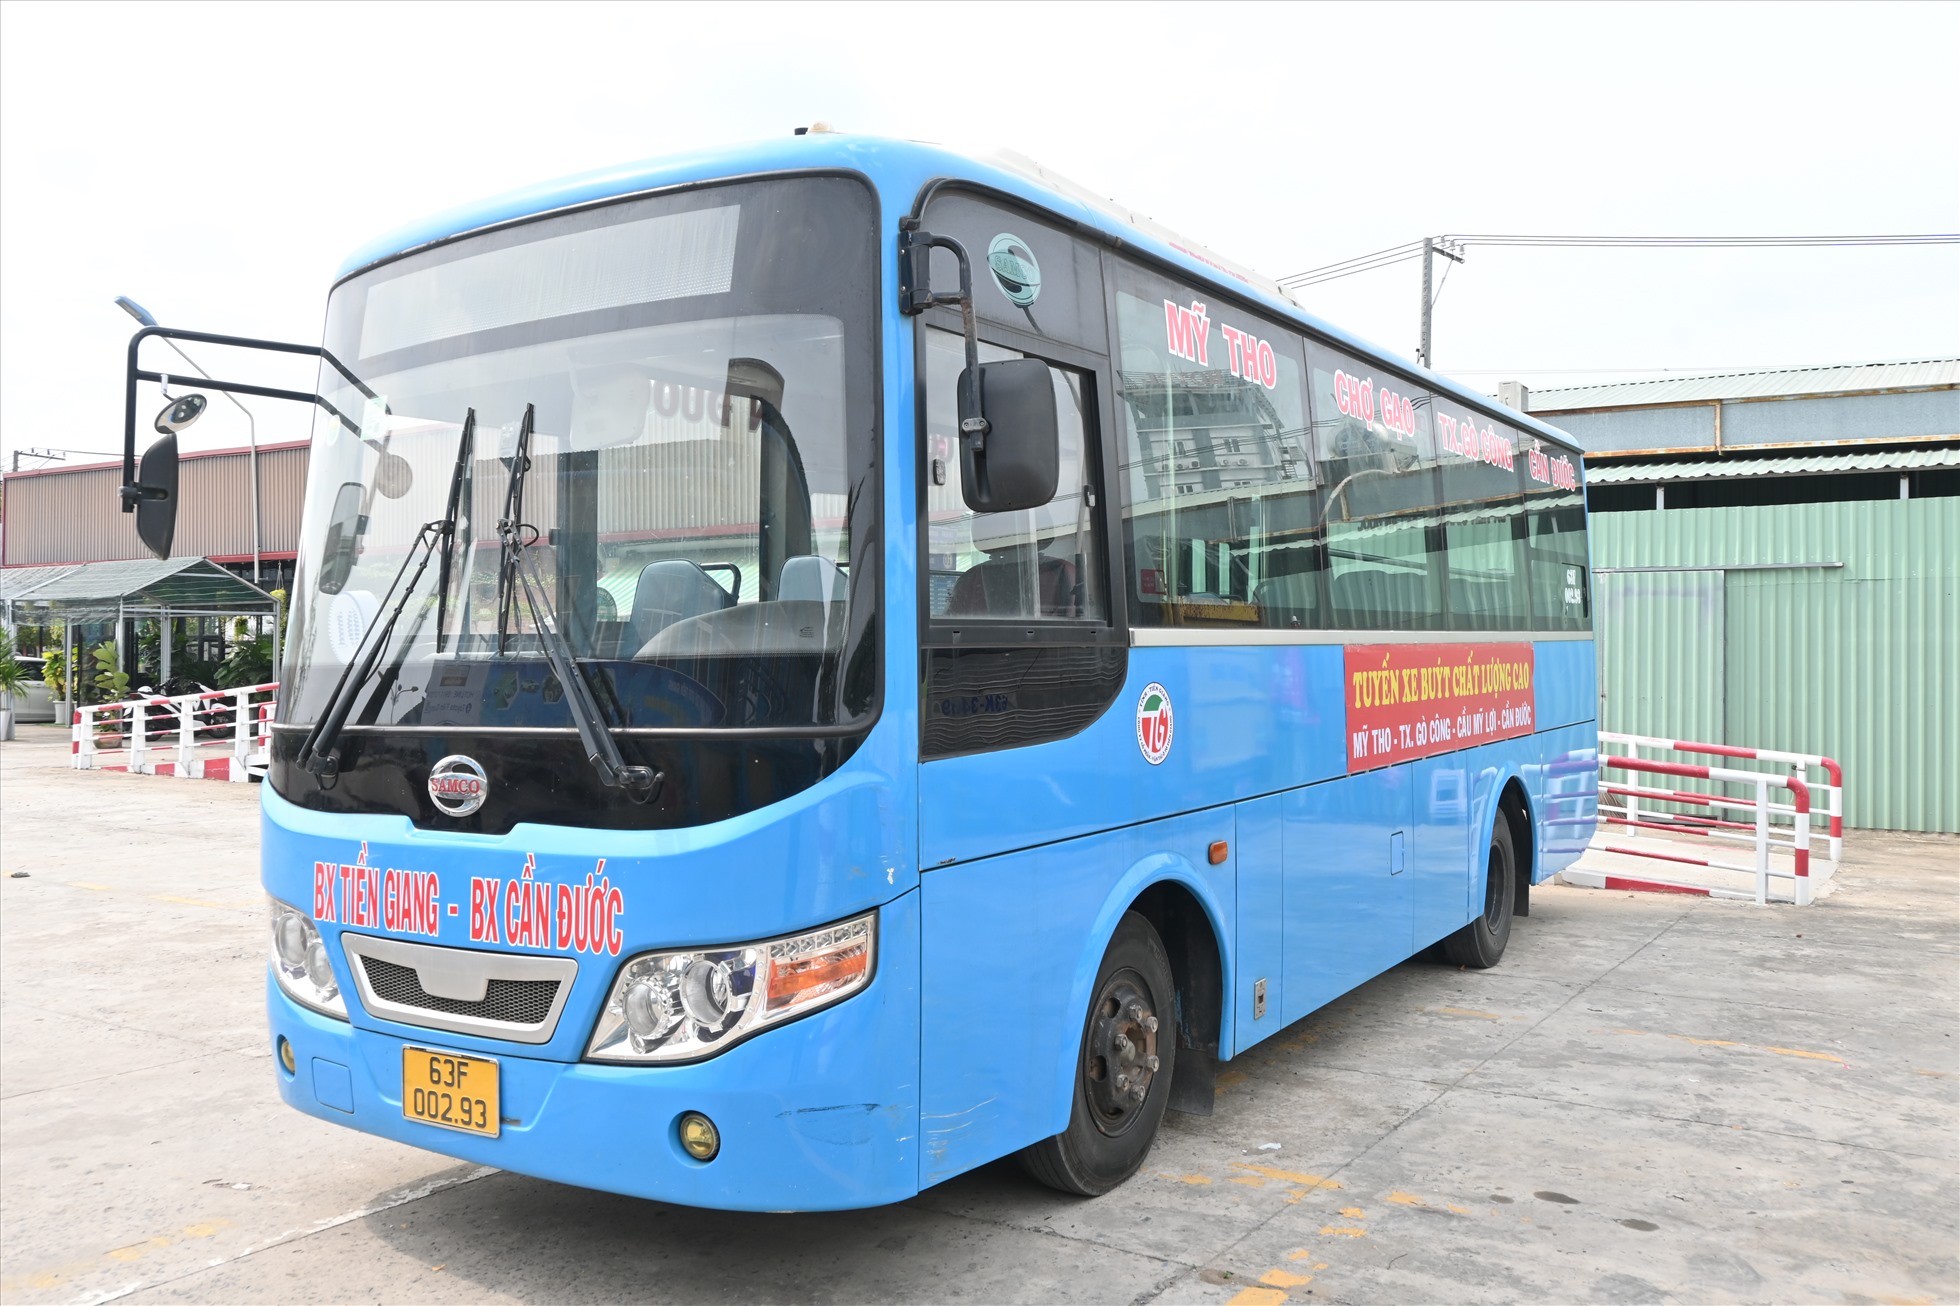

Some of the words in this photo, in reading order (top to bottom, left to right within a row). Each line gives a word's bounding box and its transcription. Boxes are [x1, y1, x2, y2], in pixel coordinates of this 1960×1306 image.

[1163, 298, 1210, 367] MỸ
[1221, 323, 1277, 390] THO
[1333, 369, 1375, 431] CHỢ
[1379, 386, 1415, 441] GẠO
[1480, 423, 1515, 473] CÔNG
[1529, 439, 1550, 485] CẦN
[1551, 454, 1576, 492] ĐƯỚC
[1353, 652, 1400, 709] TUYẾN
[1402, 668, 1418, 703] XE
[1421, 657, 1450, 701] BUÝT
[1452, 650, 1480, 697] CHẤT
[1481, 657, 1511, 699] LƯỢNG
[1513, 662, 1530, 691] CAO
[1353, 725, 1369, 759] MỸ
[1371, 728, 1392, 755] THO
[1399, 725, 1414, 749] TX.
[1416, 716, 1428, 747] GÒ
[1429, 713, 1451, 743] CÔNG
[1457, 706, 1472, 738] CẦU
[1473, 708, 1484, 735] MỸ
[1485, 708, 1497, 736] LỢI
[1501, 700, 1514, 730] CẦN
[1515, 701, 1531, 727] ĐƯỚC
[431, 777, 481, 794] SAMCO
[314, 861, 337, 922] BX
[340, 841, 380, 928] TIỀN
[383, 868, 440, 937] GIANG
[447, 904, 459, 916] -
[470, 876, 500, 944] BX
[504, 852, 551, 948] CẦN
[556, 858, 624, 956] ĐƯỚC
[429, 1056, 469, 1089] 63F
[414, 1087, 487, 1128] 002.93
